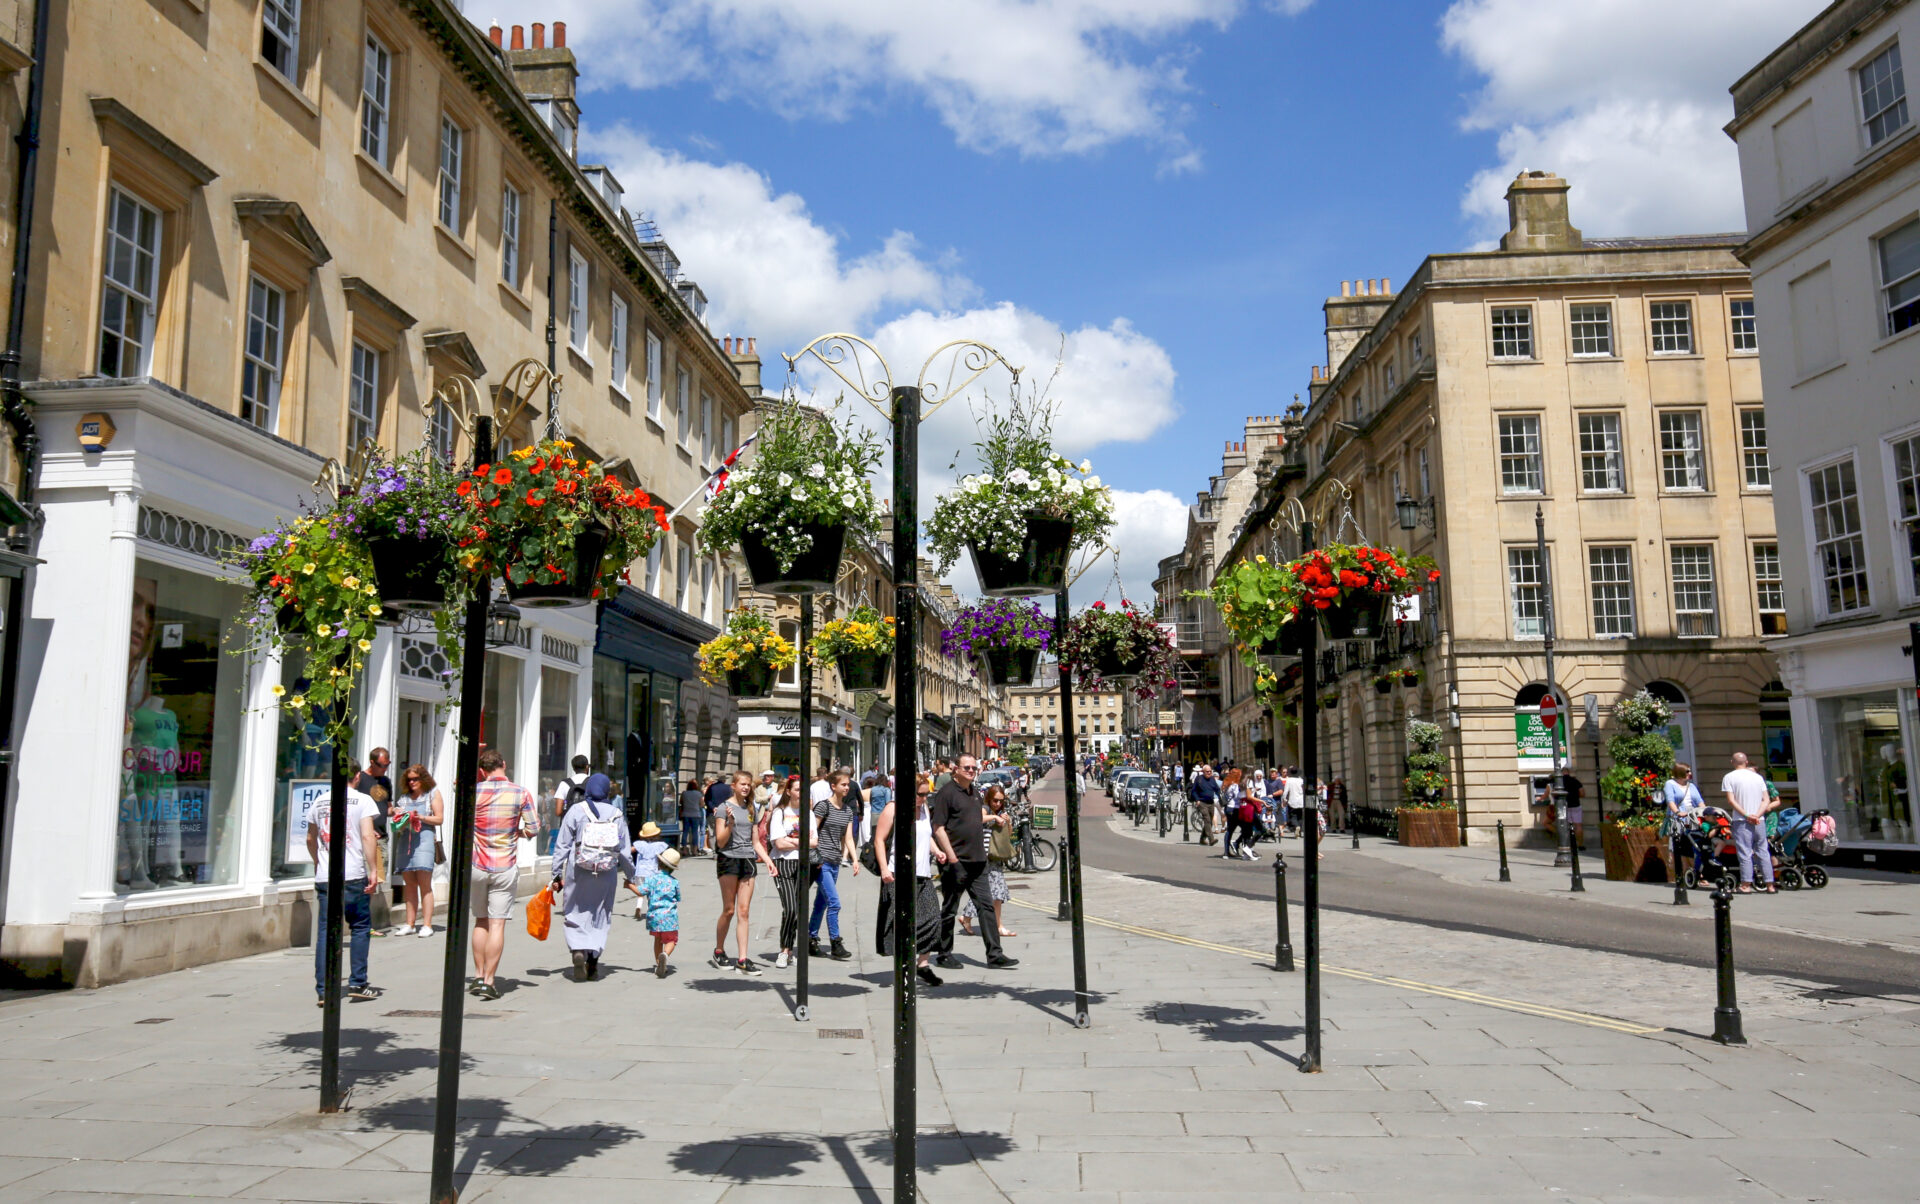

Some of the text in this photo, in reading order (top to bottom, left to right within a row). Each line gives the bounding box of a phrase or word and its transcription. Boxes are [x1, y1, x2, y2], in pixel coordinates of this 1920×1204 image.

[83, 424, 99, 433] ADT
[776, 716, 800, 731] Kieh
[122, 747, 202, 773] COLOUR
[121, 773, 175, 797] YOUR
[119, 799, 201, 823] SUMMER
